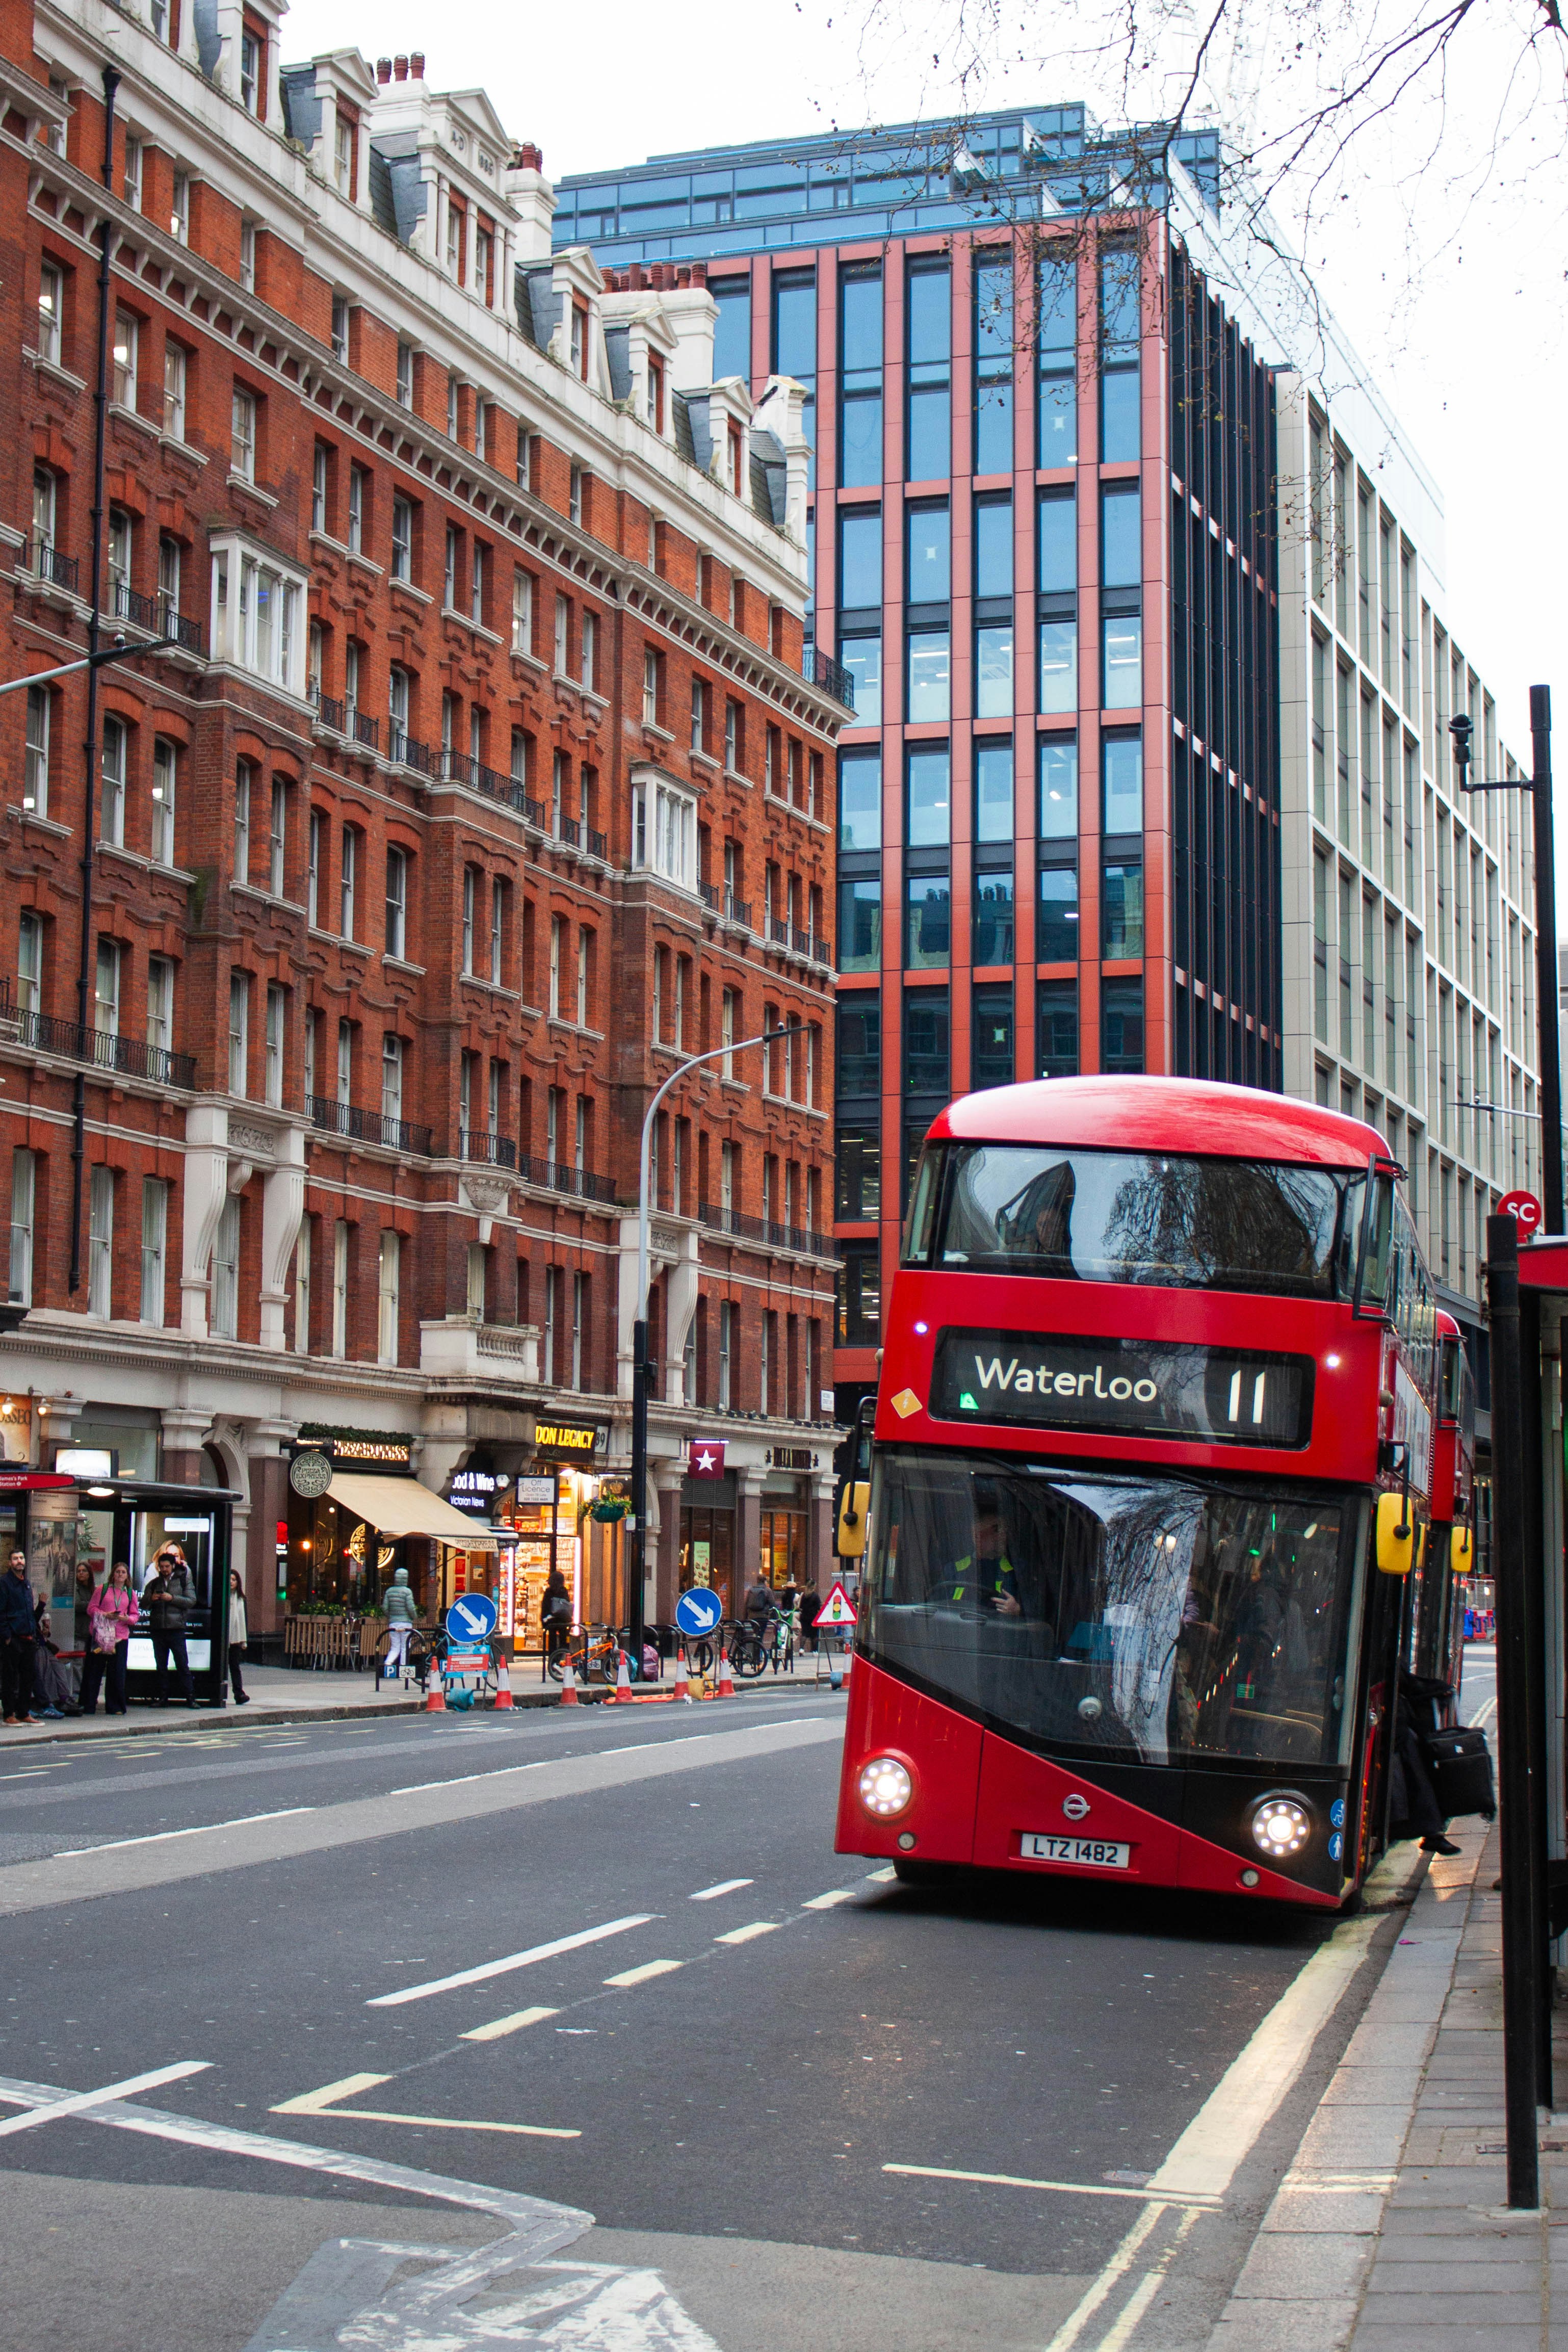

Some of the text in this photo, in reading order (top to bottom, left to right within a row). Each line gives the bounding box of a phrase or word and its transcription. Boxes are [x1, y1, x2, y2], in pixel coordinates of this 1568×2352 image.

[1507, 1202, 1535, 1222] SC
[975, 1355, 1157, 1402] Waterloo
[1229, 1369, 1265, 1423] 11
[558, 1428, 594, 1449] LEGACY
[468, 1472, 475, 1490] &
[476, 1473, 495, 1492] Wine
[450, 1495, 485, 1507] Victorian News
[386, 1666, 394, 1678] P
[1033, 1837, 1118, 1864] LTZ 1482
